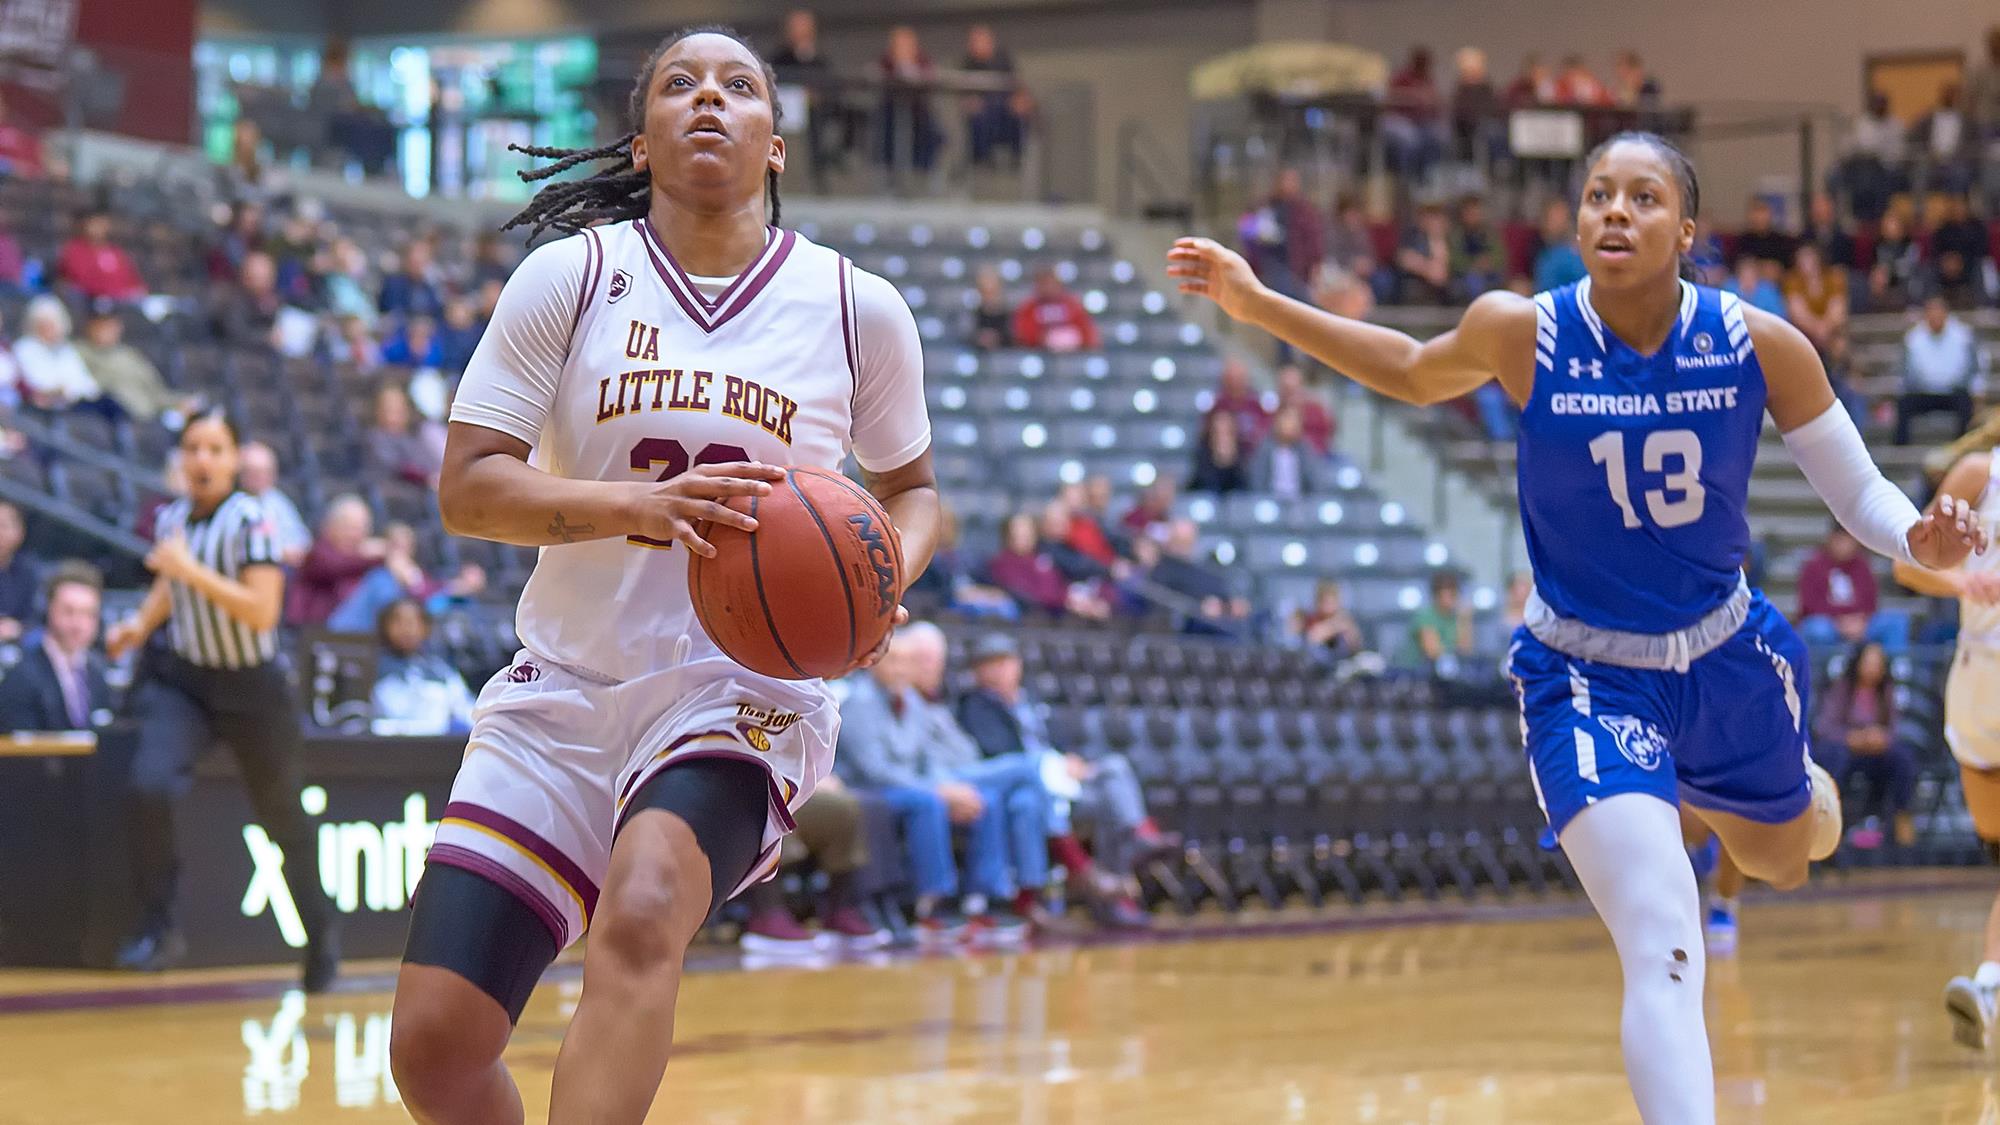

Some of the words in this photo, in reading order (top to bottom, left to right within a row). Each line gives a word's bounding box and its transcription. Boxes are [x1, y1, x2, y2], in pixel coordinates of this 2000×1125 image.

[626, 320, 660, 361] UA
[596, 369, 714, 425] LITTLE
[722, 374, 798, 448] ROCK
[1551, 392, 1661, 416] GEORGIA
[1665, 386, 1738, 414] STATE
[1588, 429, 1706, 528] 13
[848, 512, 897, 618] NCAA
